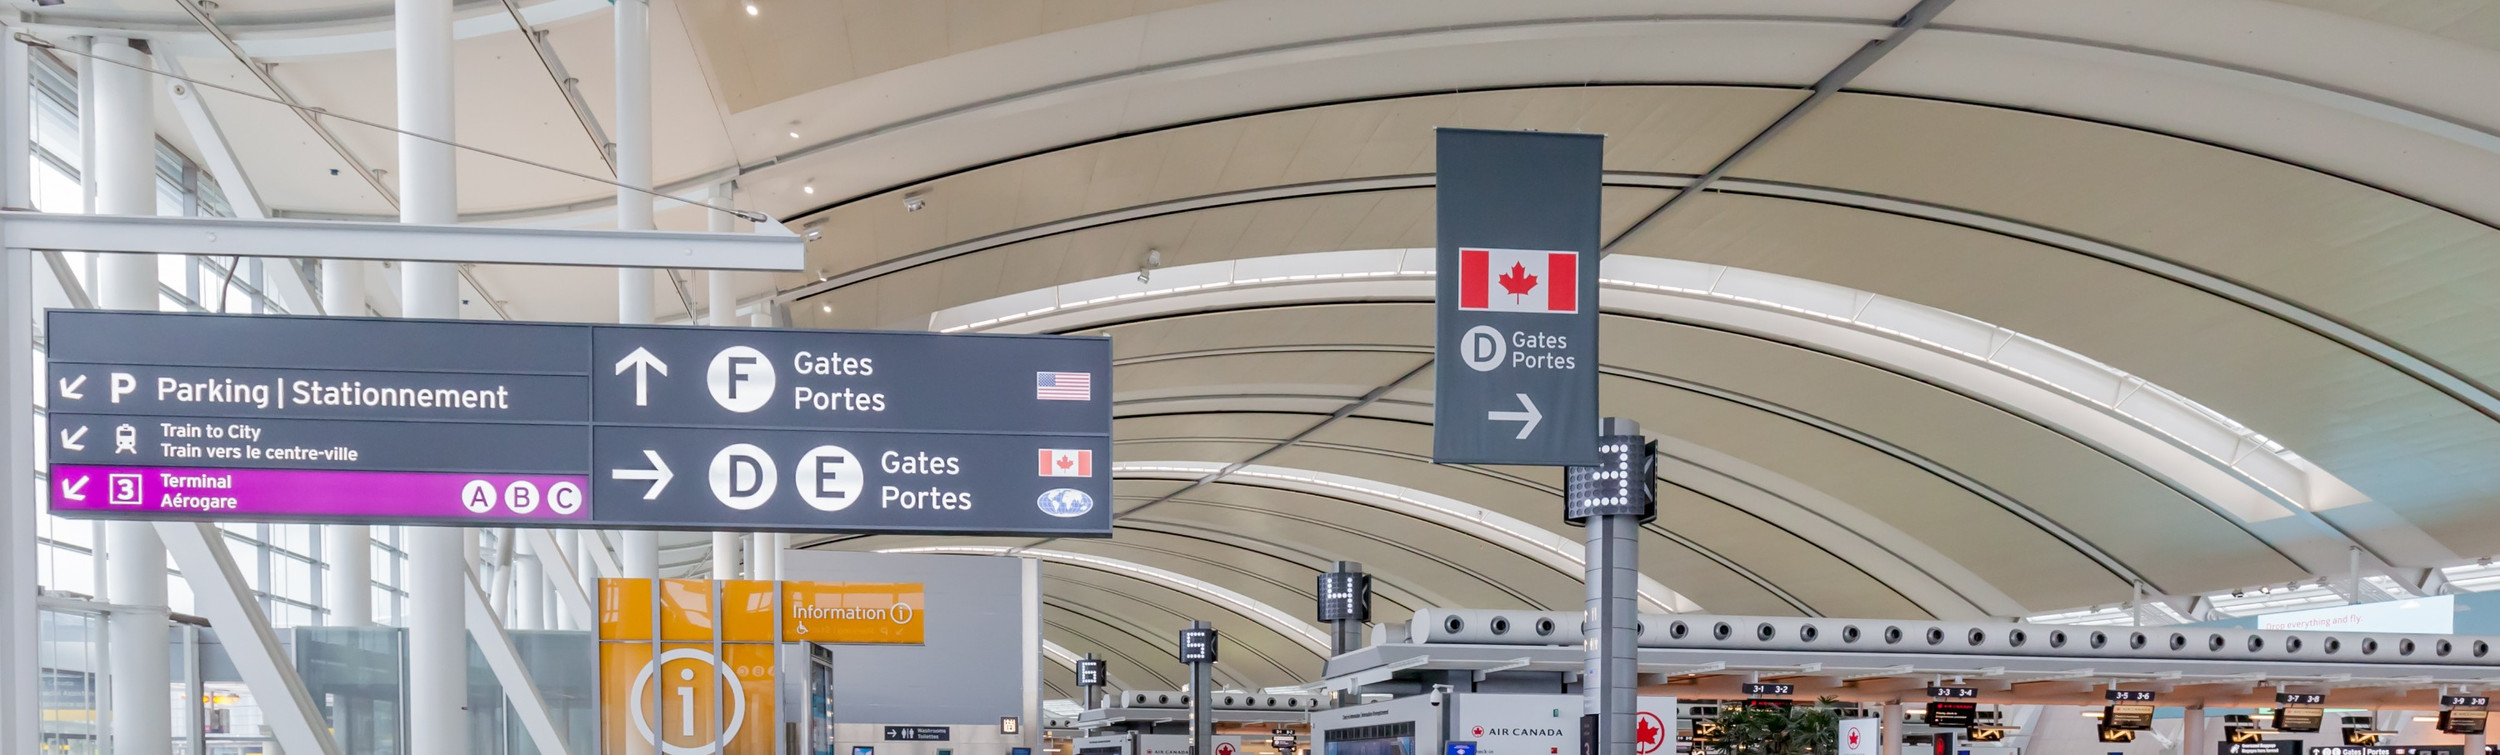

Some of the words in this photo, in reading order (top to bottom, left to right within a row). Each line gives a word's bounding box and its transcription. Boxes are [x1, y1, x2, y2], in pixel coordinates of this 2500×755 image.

[1473, 332, 1497, 363] D
[1512, 331, 1567, 349] Gates
[794, 350, 873, 376] Gates
[1512, 351, 1575, 369] Portes
[728, 356, 757, 400] F
[111, 372, 137, 403] P
[157, 377, 269, 409] Parking
[292, 380, 509, 410] Stationnement
[795, 386, 886, 412] Portes
[160, 422, 202, 438] Train
[206, 424, 224, 439] to
[227, 424, 262, 442] City
[160, 442, 202, 458] Train
[206, 446, 242, 459] vers
[246, 444, 261, 459] le
[265, 445, 358, 462] centre-ville
[881, 450, 960, 475] Gates
[160, 473, 232, 489] Terminal
[729, 454, 763, 498] D
[815, 456, 846, 499] E
[1584, 443, 1628, 506] 3
[117, 478, 134, 501] 3
[469, 486, 489, 507] A
[514, 487, 530, 508] B
[556, 487, 574, 509] C
[882, 485, 972, 511] Portes
[160, 492, 238, 511] Aérogare
[1327, 577, 1353, 614] 4
[793, 604, 886, 620] Information
[2287, 618, 2331, 629] everything
[2333, 615, 2348, 624] and
[1186, 631, 1205, 659] 5
[1081, 661, 1097, 683] 6
[1489, 728, 1509, 736] AIR
[1512, 728, 1563, 737] CANADA
